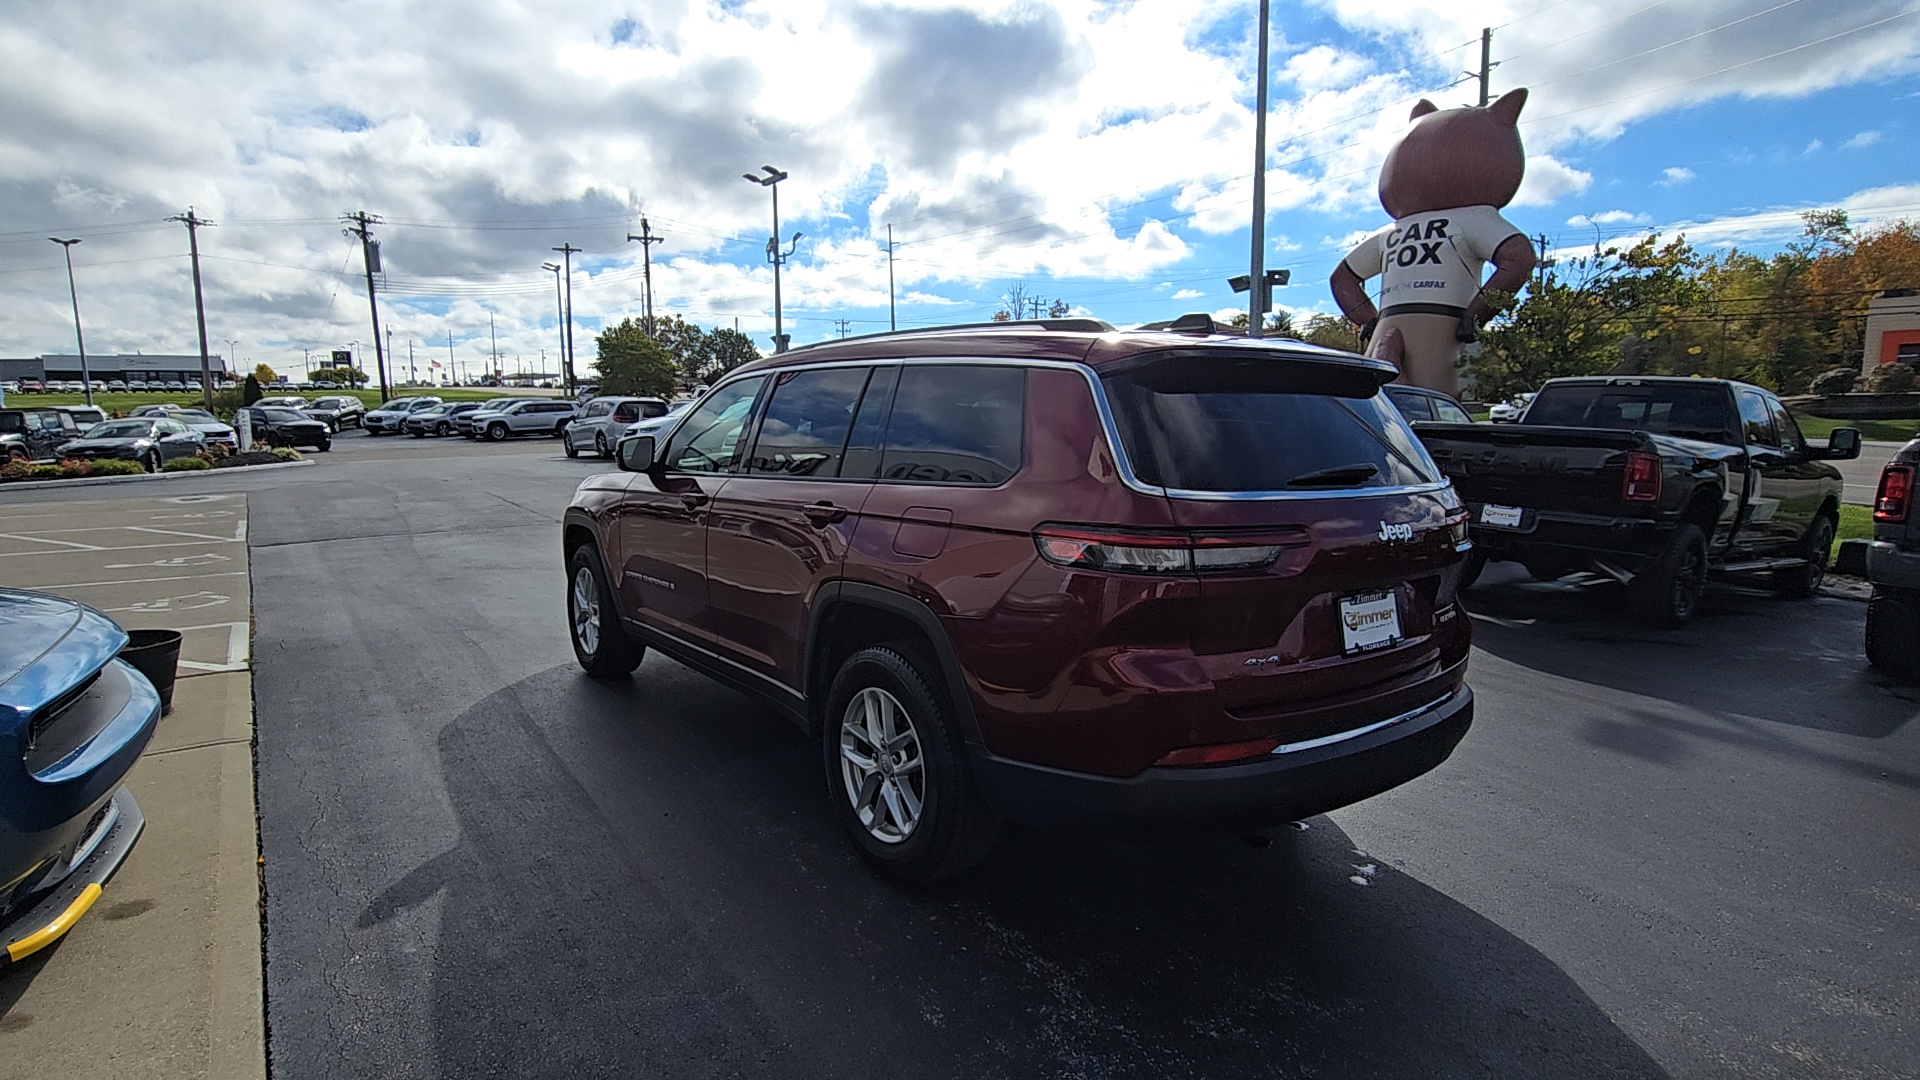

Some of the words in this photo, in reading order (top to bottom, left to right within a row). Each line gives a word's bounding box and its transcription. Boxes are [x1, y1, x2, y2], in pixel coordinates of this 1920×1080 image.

[1386, 218, 1450, 249] CAR
[1384, 241, 1443, 273] FOX
[1413, 280, 1446, 289] CARFAX
[1378, 520, 1413, 543] Jeep
[1355, 592, 1382, 604] Zimmer
[1345, 608, 1394, 630] Zimmer
